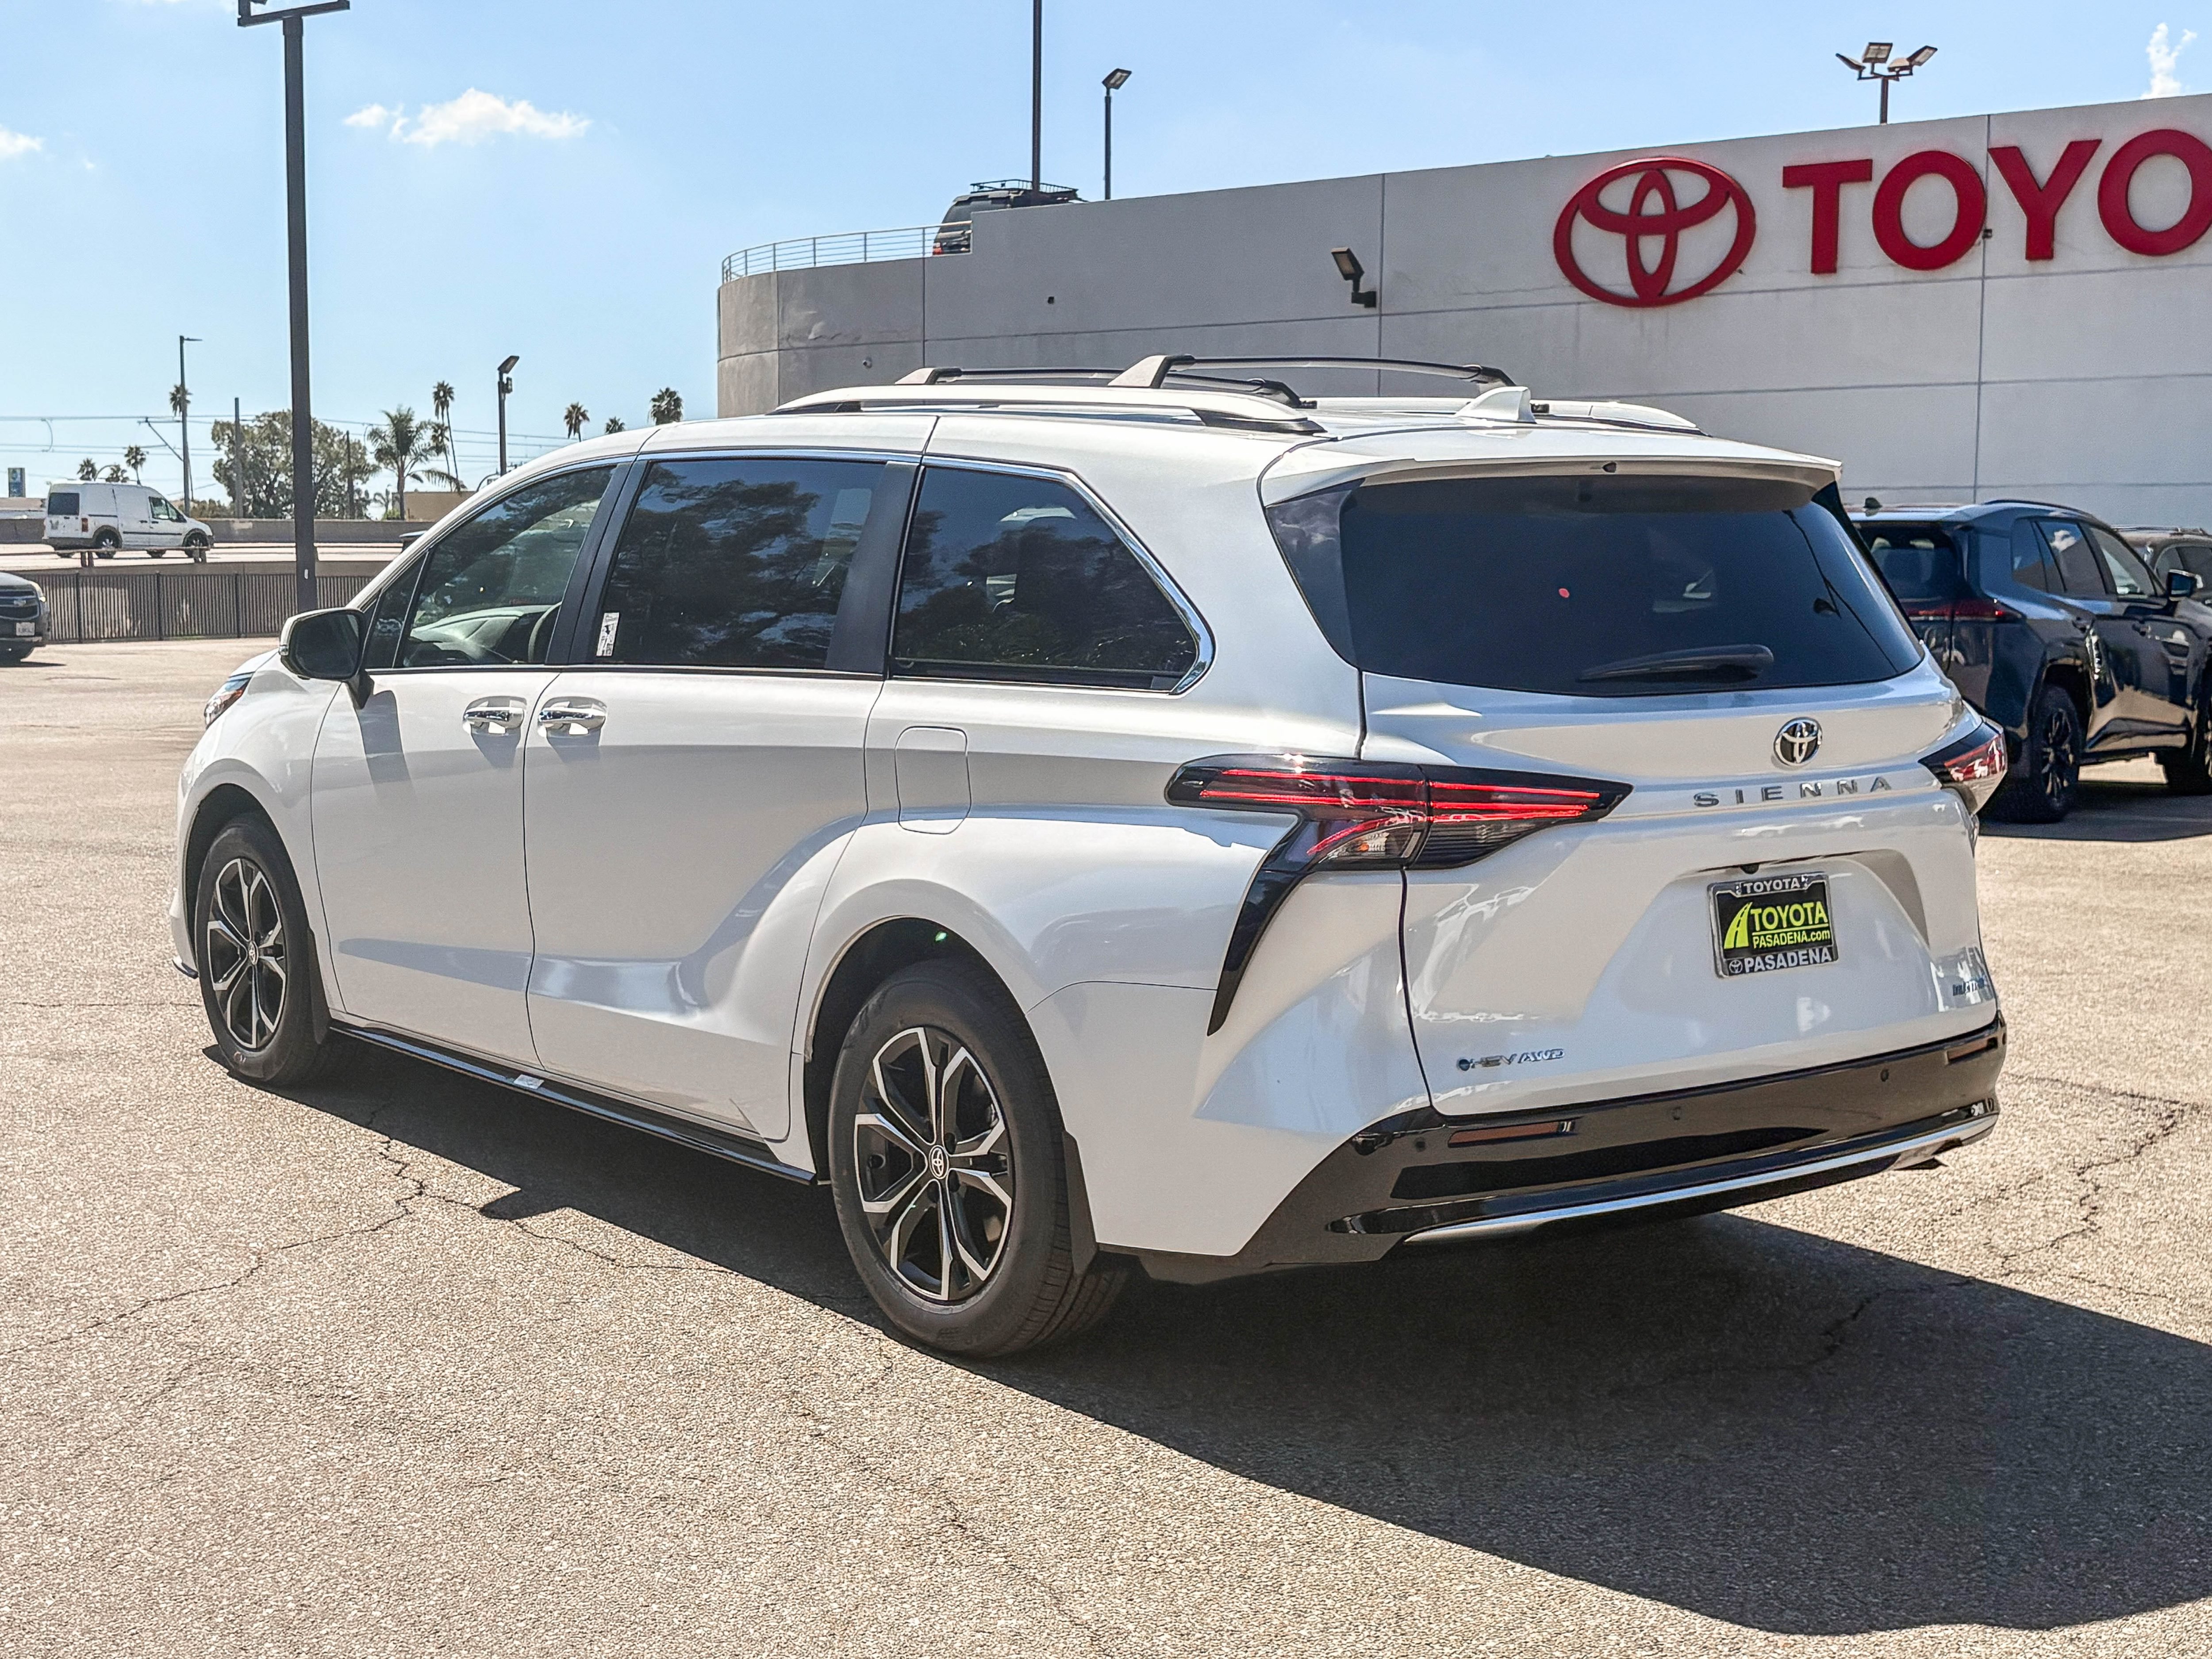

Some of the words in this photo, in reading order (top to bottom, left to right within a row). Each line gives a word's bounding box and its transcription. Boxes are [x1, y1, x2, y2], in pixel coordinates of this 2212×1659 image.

[1782, 129, 2212, 274] TOYO
[1693, 776, 1892, 807] SIENNA
[1743, 877, 1801, 894] TOYOTA
[1751, 901, 1828, 931] TOYOTA
[1753, 930, 1830, 949] PASADENA.com
[1744, 948, 1832, 972] PASADENA
